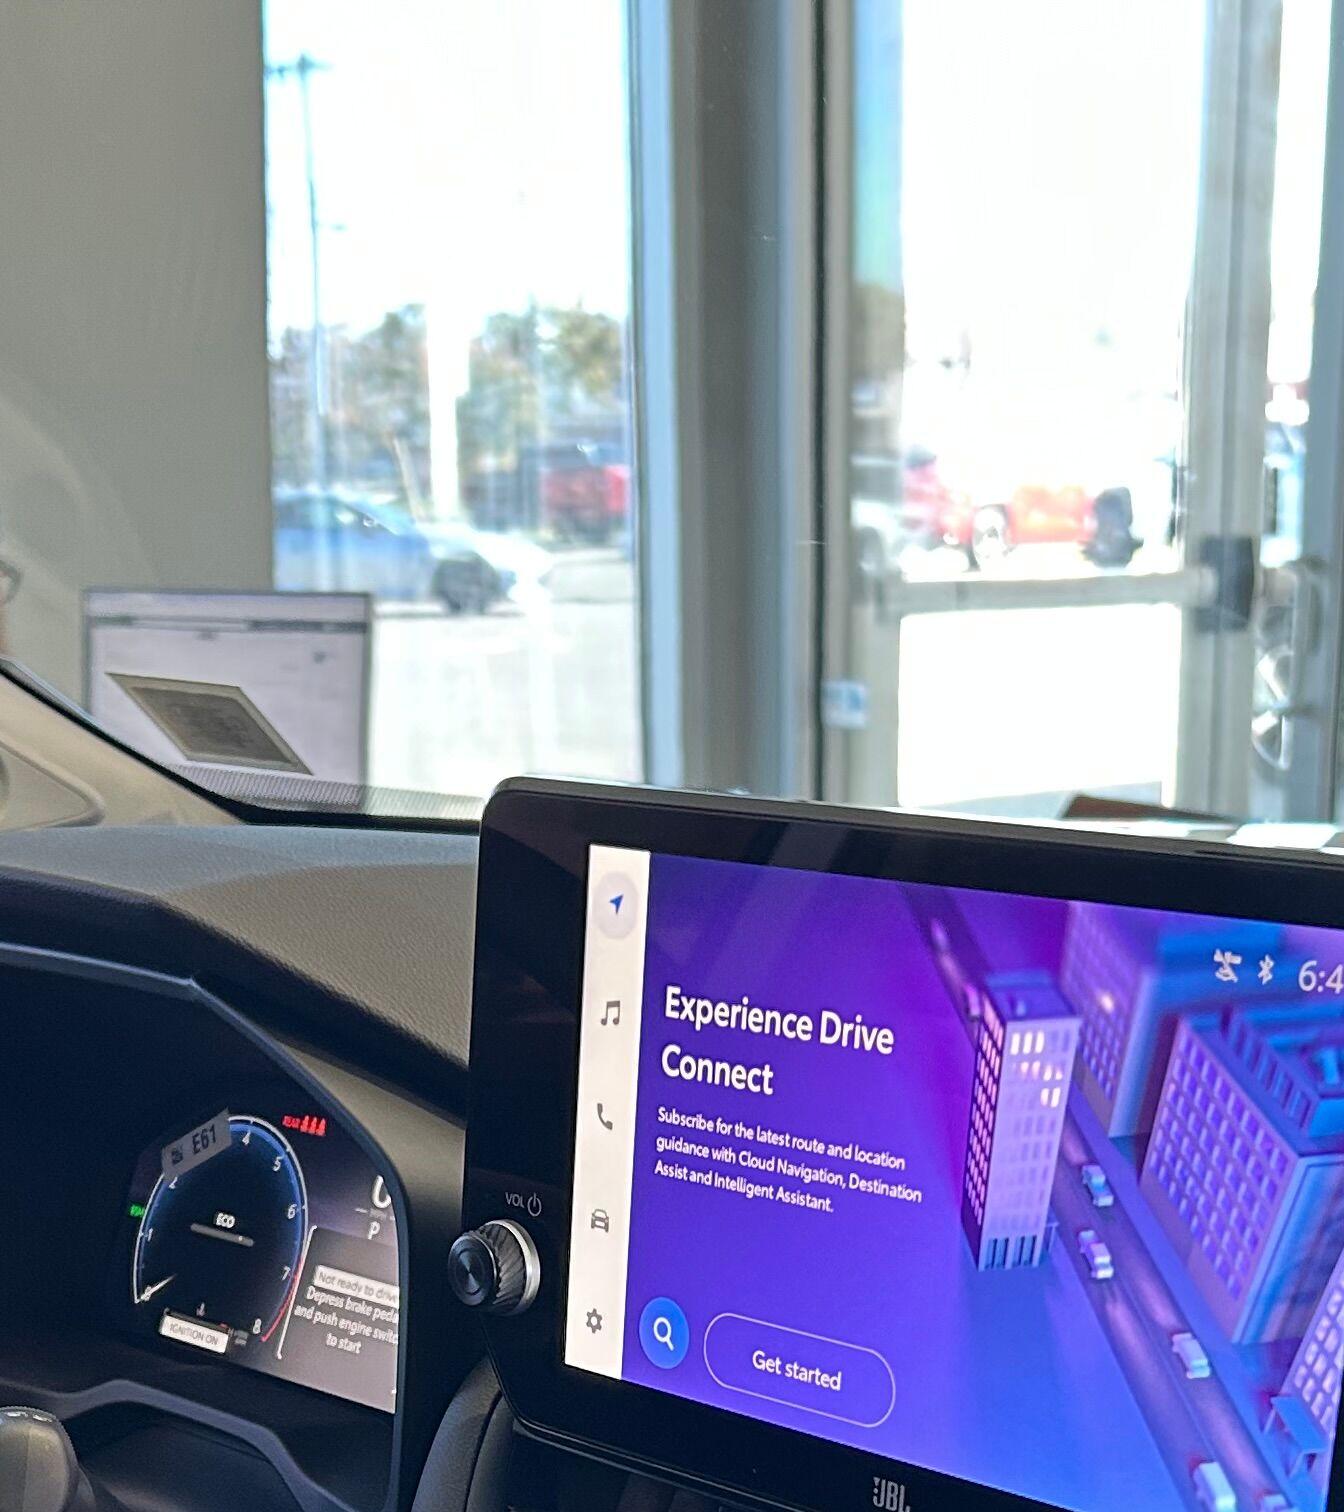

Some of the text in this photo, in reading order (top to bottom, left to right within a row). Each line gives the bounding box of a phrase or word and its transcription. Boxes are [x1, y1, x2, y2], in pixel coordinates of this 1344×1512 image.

[665, 985, 894, 1055] Experience Drive
[661, 1044, 774, 1095] Connect
[192, 1123, 216, 1154] E61
[658, 1107, 905, 1170] Subscribe for the latest route and location
[273, 1155, 283, 1172] 5
[656, 1135, 922, 1203] guidance with Cloud Navigation, Destination
[655, 1159, 834, 1212] Assist and Intelligent Assistant.
[287, 1203, 297, 1220] 6
[505, 1192, 525, 1208] VOL
[216, 1212, 236, 1229] ECO
[368, 1221, 381, 1240] P
[281, 1266, 290, 1281] 7
[319, 1272, 335, 1286] Not
[337, 1279, 363, 1295] ready
[364, 1285, 375, 1297] to
[306, 1285, 345, 1308] Depress
[345, 1297, 373, 1316] brake
[253, 1318, 262, 1334] 8
[294, 1304, 315, 1319] and
[313, 1311, 338, 1326] push
[338, 1318, 372, 1336] engine
[170, 1323, 204, 1343] IGNITION
[326, 1333, 362, 1354] to start
[752, 1350, 842, 1391] Get started
